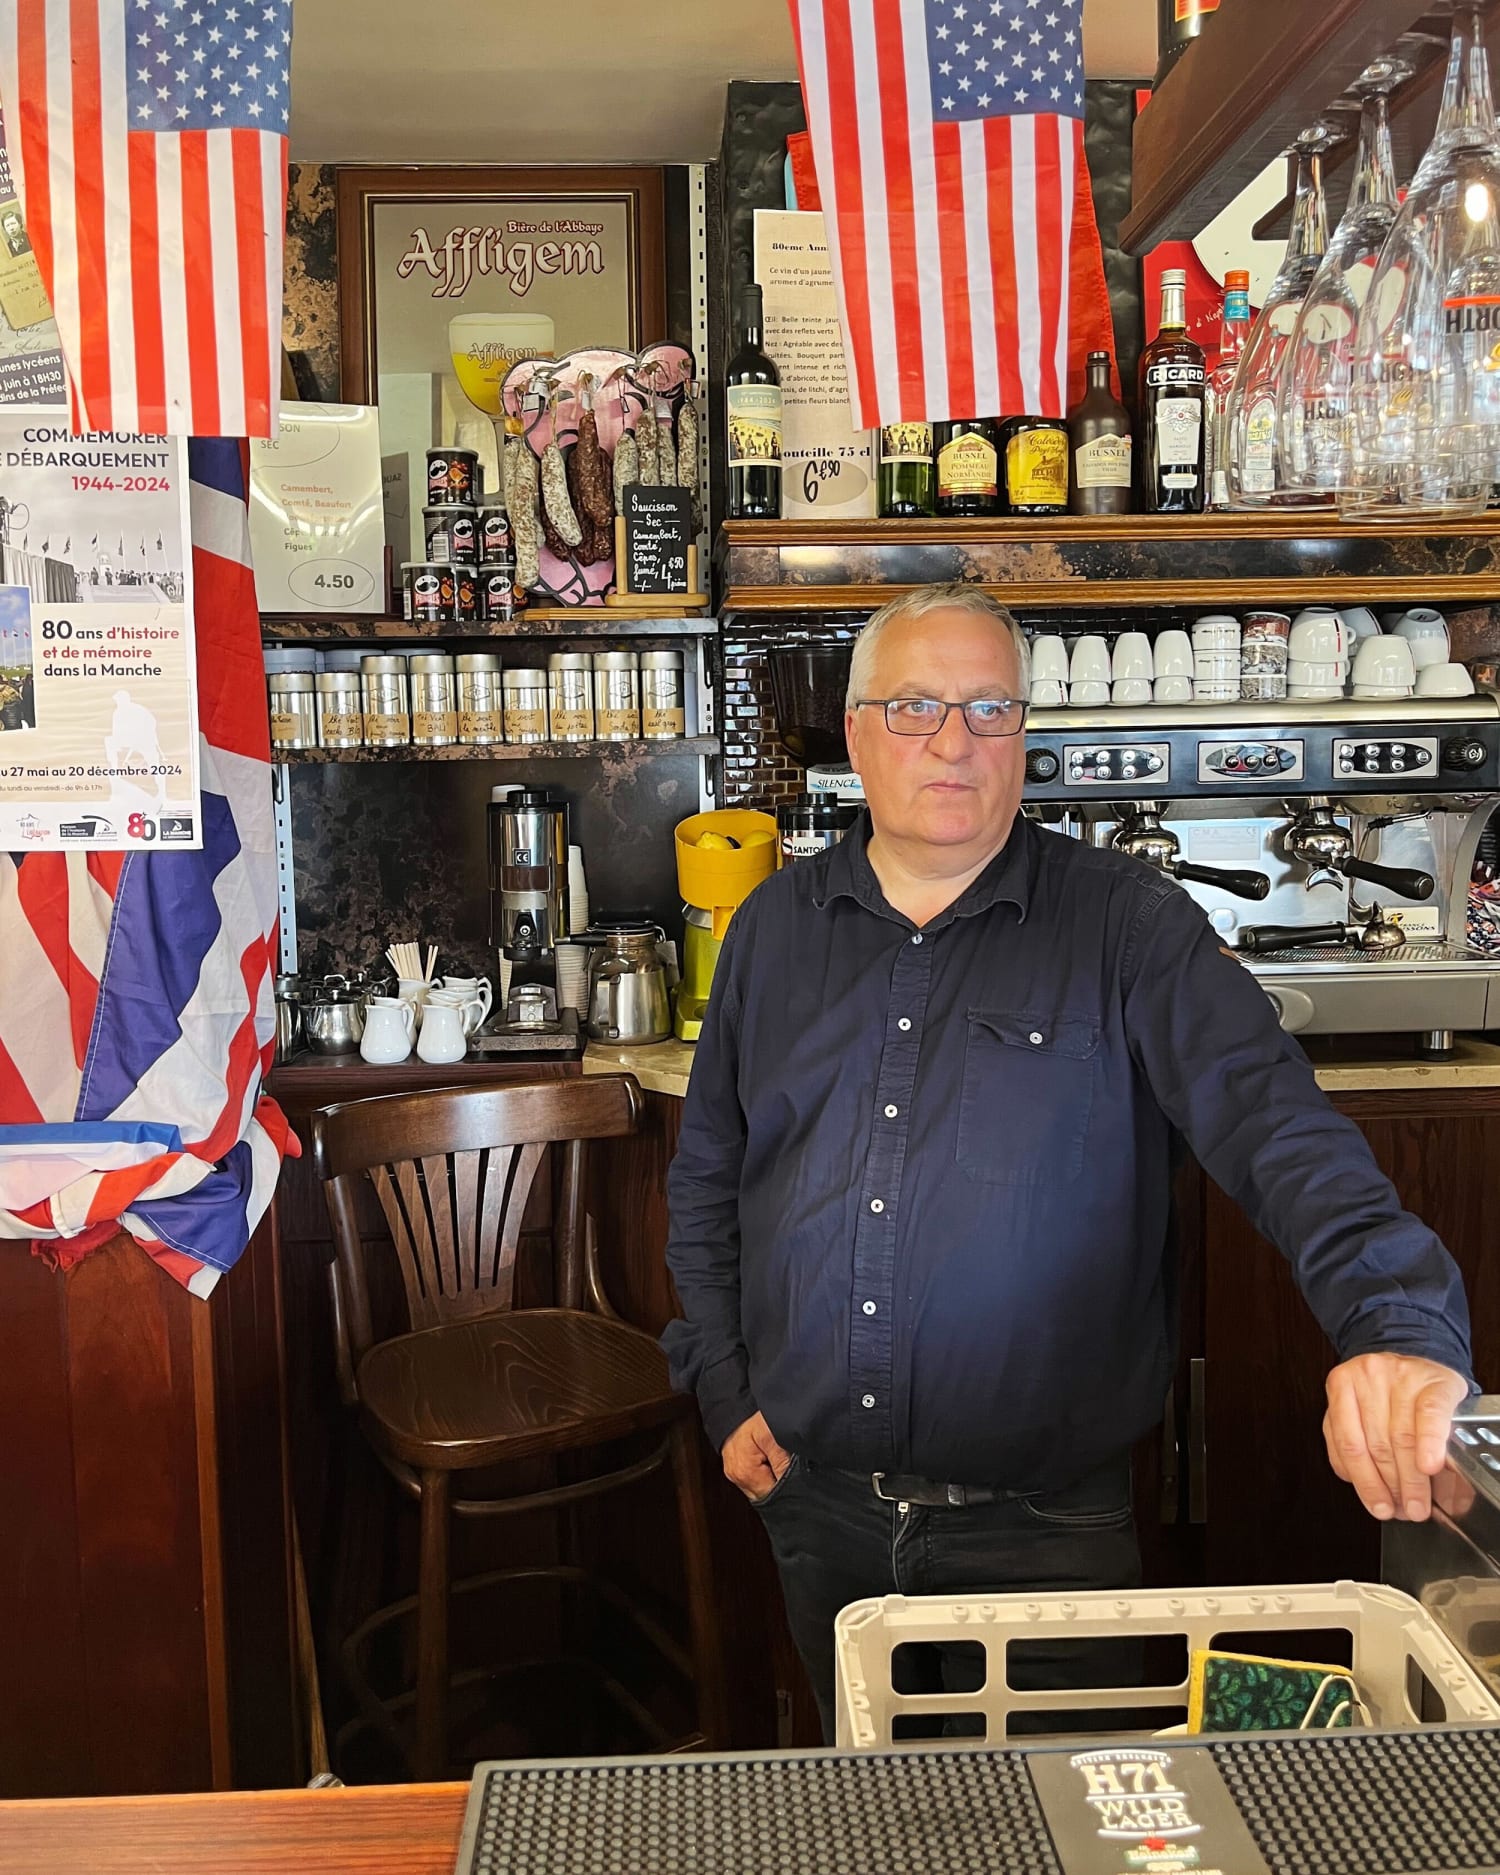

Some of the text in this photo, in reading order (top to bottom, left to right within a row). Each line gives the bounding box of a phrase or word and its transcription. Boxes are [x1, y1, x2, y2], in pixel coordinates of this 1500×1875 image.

[507, 220, 537, 234] Bière
[539, 221, 553, 233] de
[396, 225, 605, 298] Affligem
[783, 341, 813, 349] Agréable
[467, 342, 537, 369] Affligem
[31, 370, 61, 385] 18H30
[1153, 368, 1204, 381] RICARD
[260, 440, 280, 450] SEC
[783, 446, 870, 457] outeille 75 cl
[7, 448, 169, 468] DÉBARQUEMENT
[72, 476, 170, 491] 1944-2024
[632, 494, 678, 512] Saucisson
[646, 513, 662, 527] Sec
[285, 542, 313, 552] Figues
[314, 574, 354, 588] 4.50
[42, 620, 180, 640] 80 ans d'histoire
[42, 645, 152, 659] et de mémoire
[43, 664, 162, 677] dans la Manche
[10, 766, 24, 777] 27
[27, 767, 49, 777] mai
[52, 768, 66, 777] au
[69, 766, 84, 776] 20
[87, 765, 148, 777] décembre
[150, 765, 182, 775] 2024
[817, 778, 857, 788] SILENCE
[127, 812, 157, 841] 80
[1079, 1762, 1176, 1794] H71
[1094, 1797, 1185, 1817] WILD
[1101, 1812, 1193, 1830] LAGER
